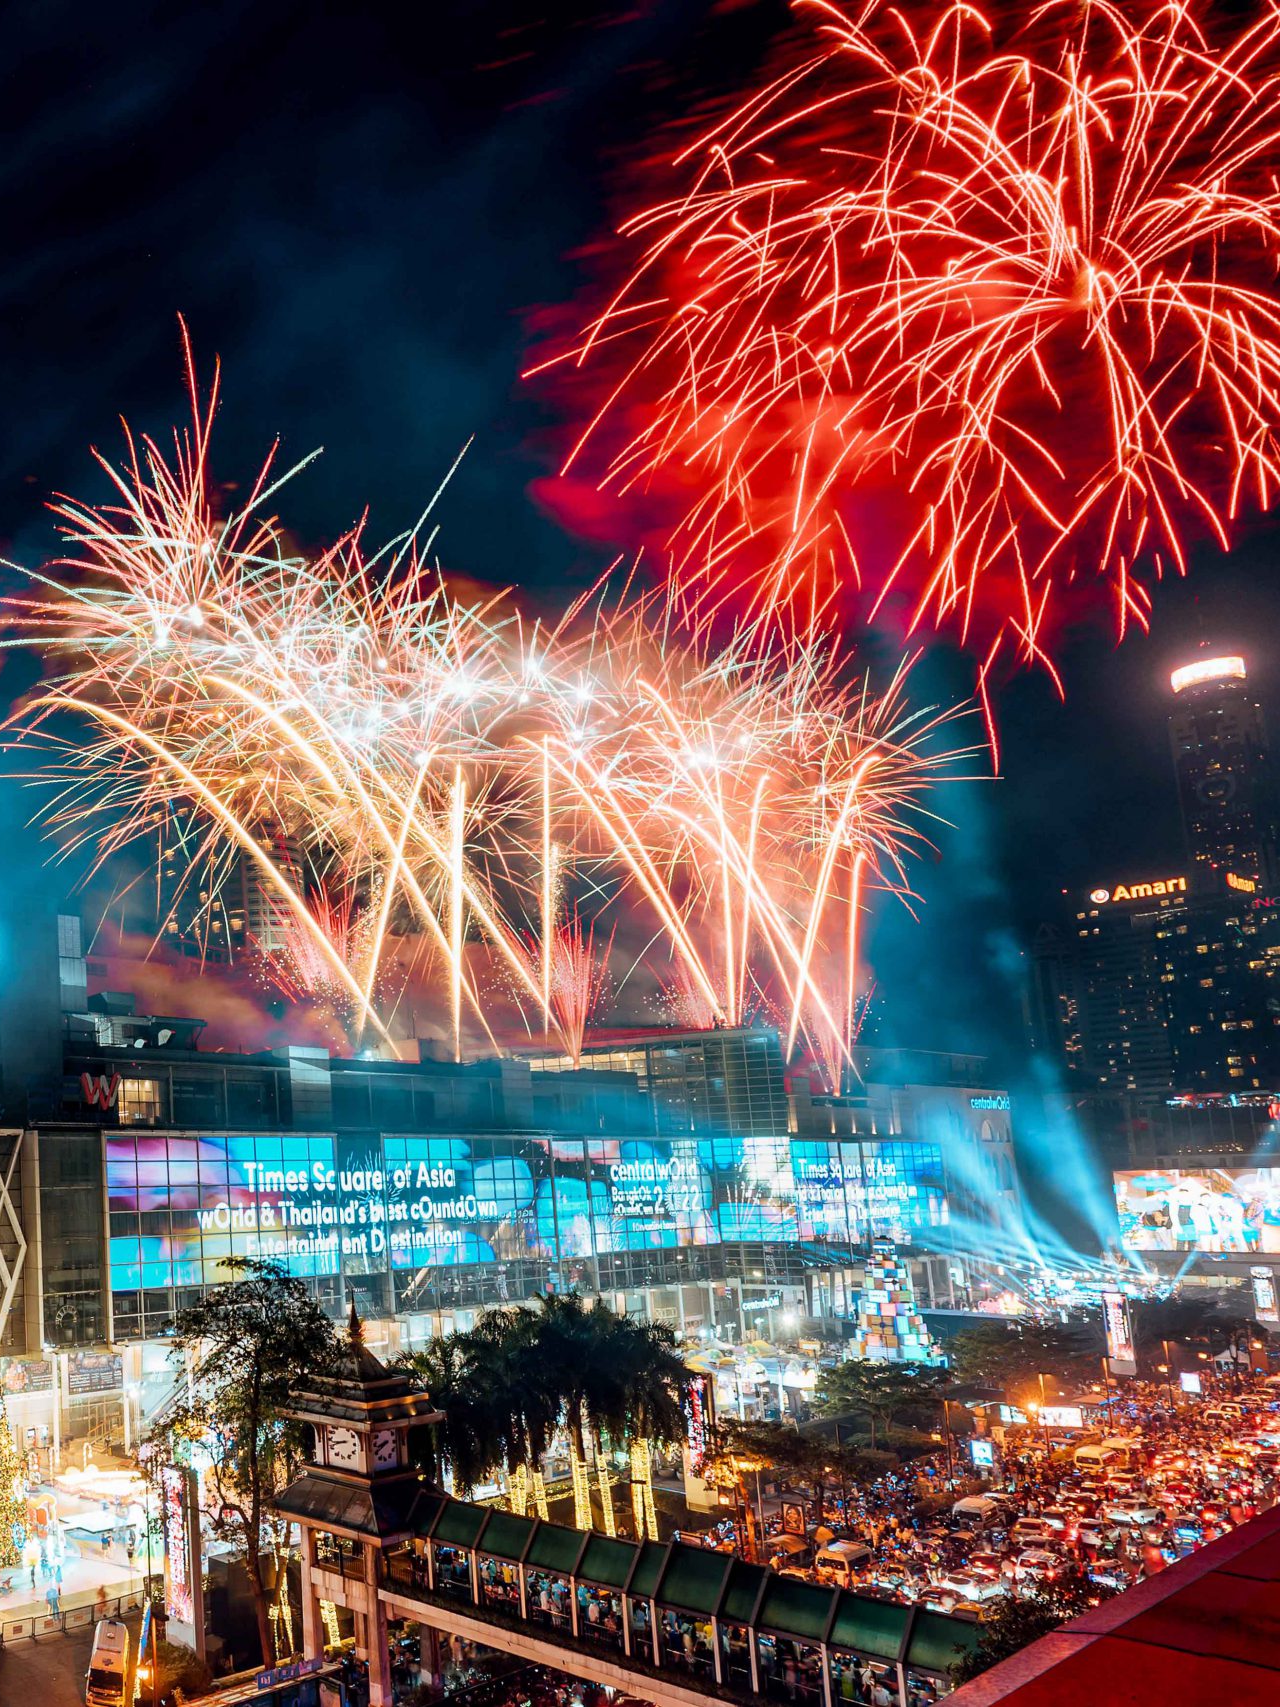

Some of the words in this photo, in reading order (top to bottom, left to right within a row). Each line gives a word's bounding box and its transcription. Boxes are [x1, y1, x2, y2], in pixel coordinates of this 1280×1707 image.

[1111, 877, 1187, 902] Amari
[243, 1162, 309, 1193] Times
[393, 1161, 412, 1189] of
[416, 1161, 456, 1188] Asia
[610, 1157, 698, 1181] centralwOrld
[197, 1201, 256, 1230] wOrld
[261, 1201, 276, 1227] &
